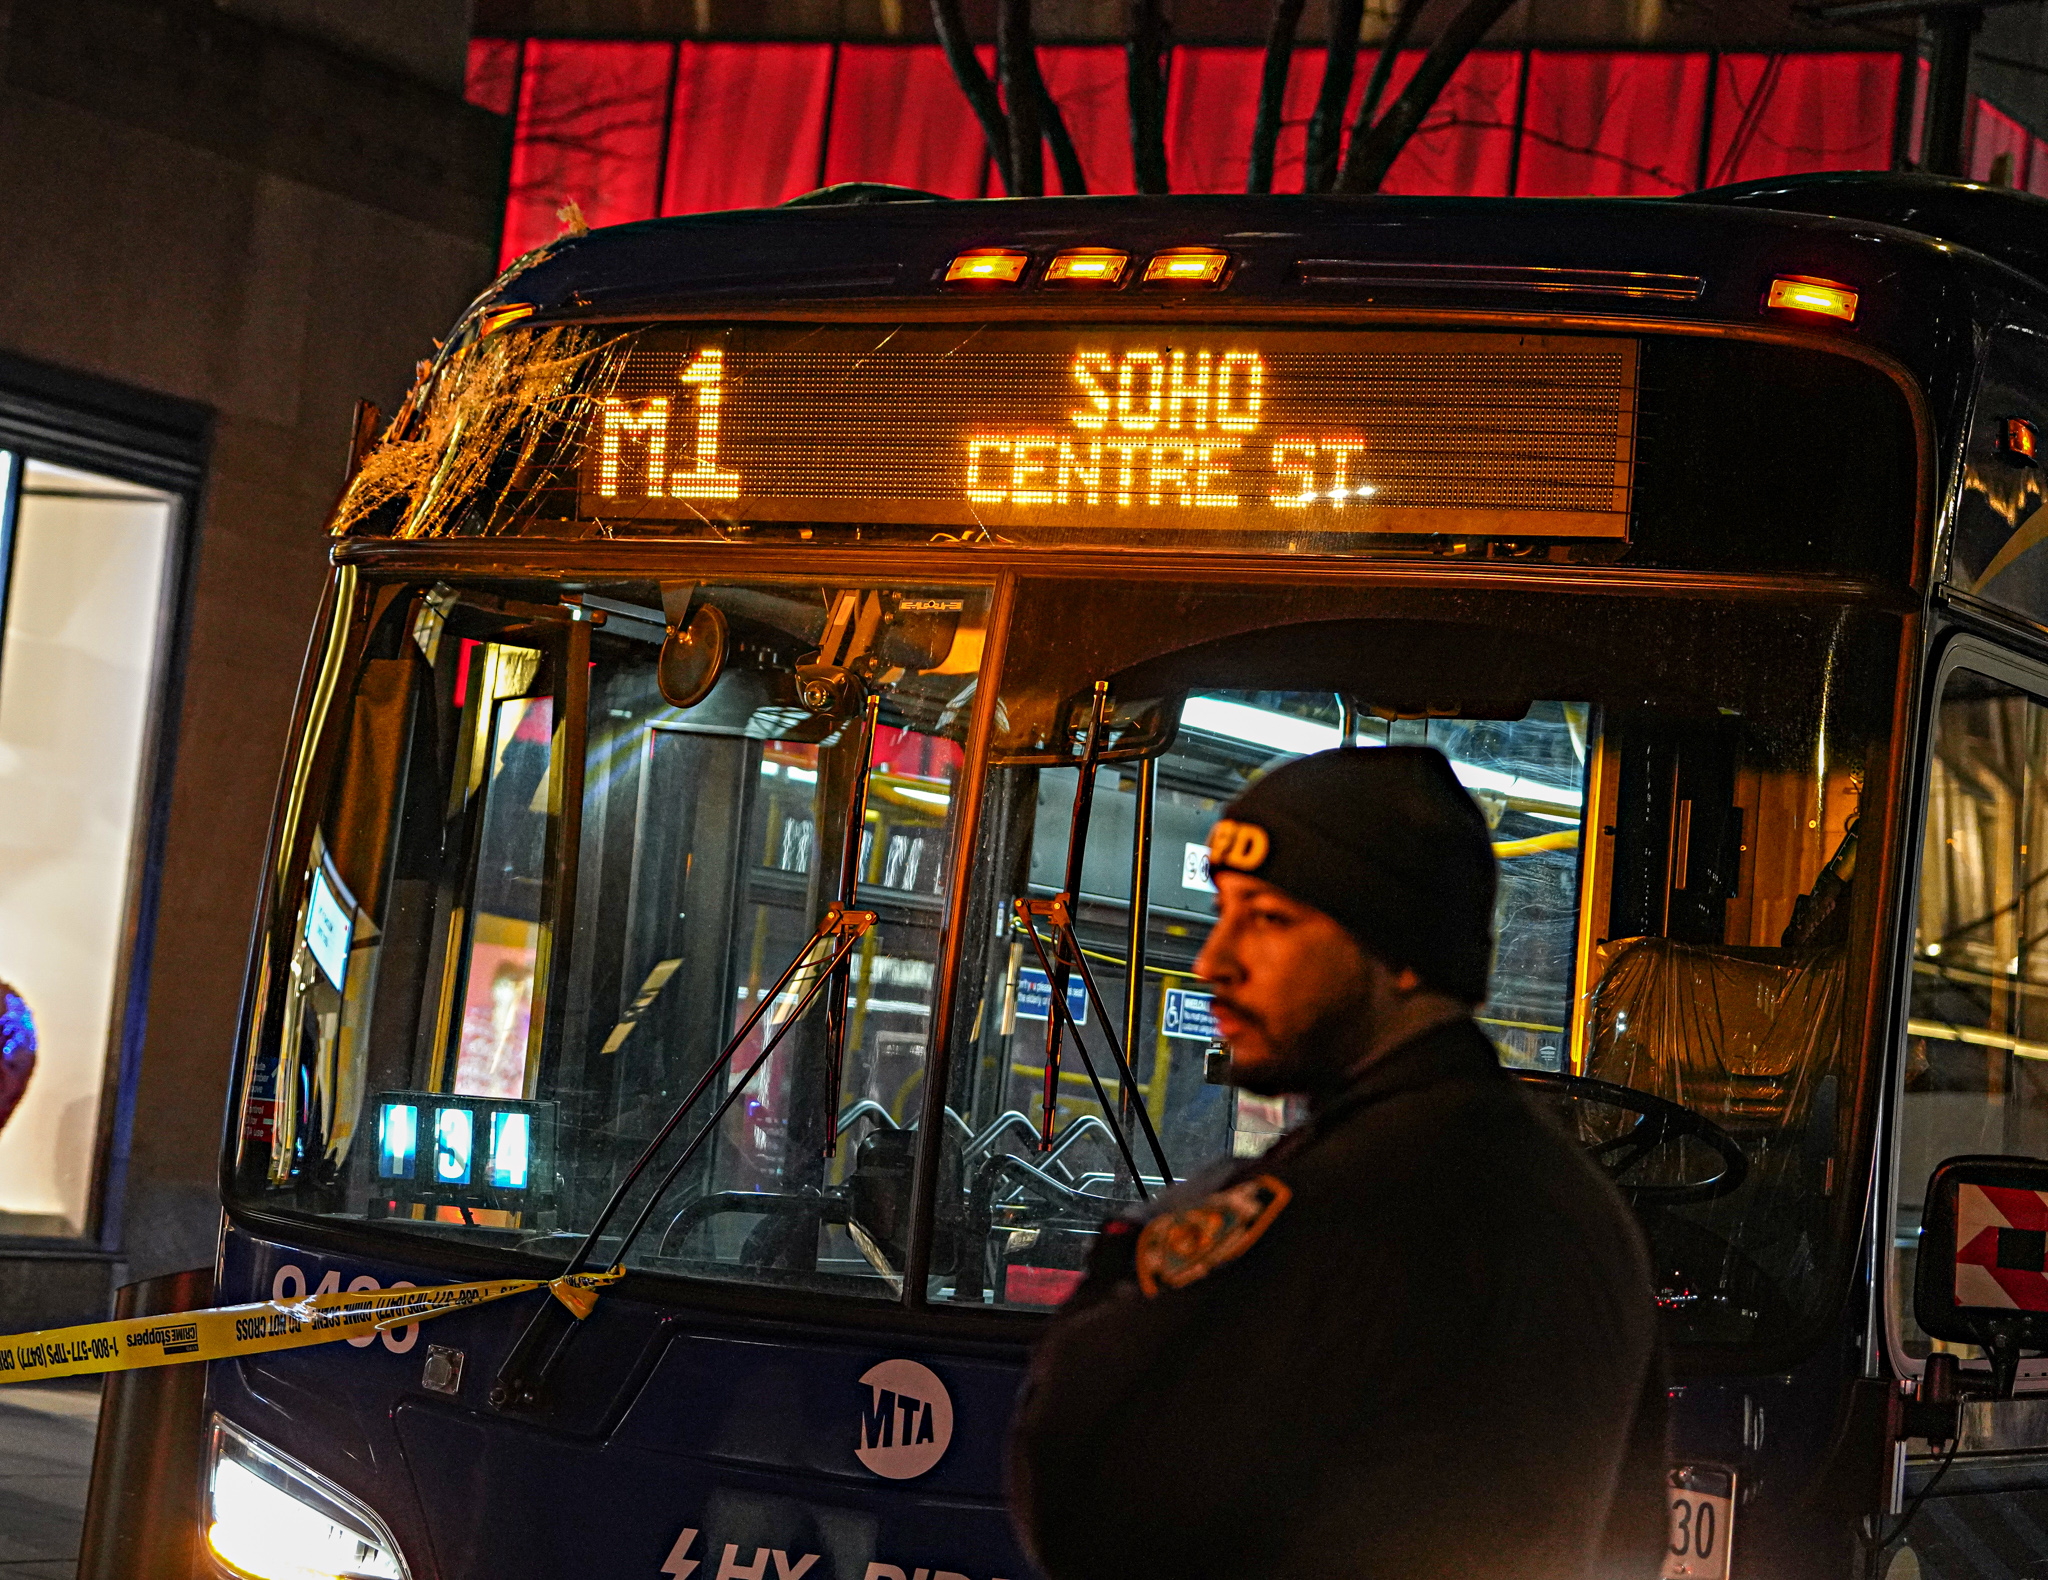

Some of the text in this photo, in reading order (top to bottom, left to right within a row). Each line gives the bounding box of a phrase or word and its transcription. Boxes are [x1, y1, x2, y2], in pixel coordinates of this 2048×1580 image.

[1072, 351, 1264, 431] SOHO
[601, 350, 740, 498] M1
[967, 434, 1365, 509] CENTRE ST
[0, 1336, 119, 1372] 1-800-577-TIPS (8477) CRI
[236, 1316, 267, 1341] CROSS
[267, 1314, 287, 1337] NOT
[855, 1379, 935, 1450] MTA
[1670, 1499, 1716, 1559] 30
